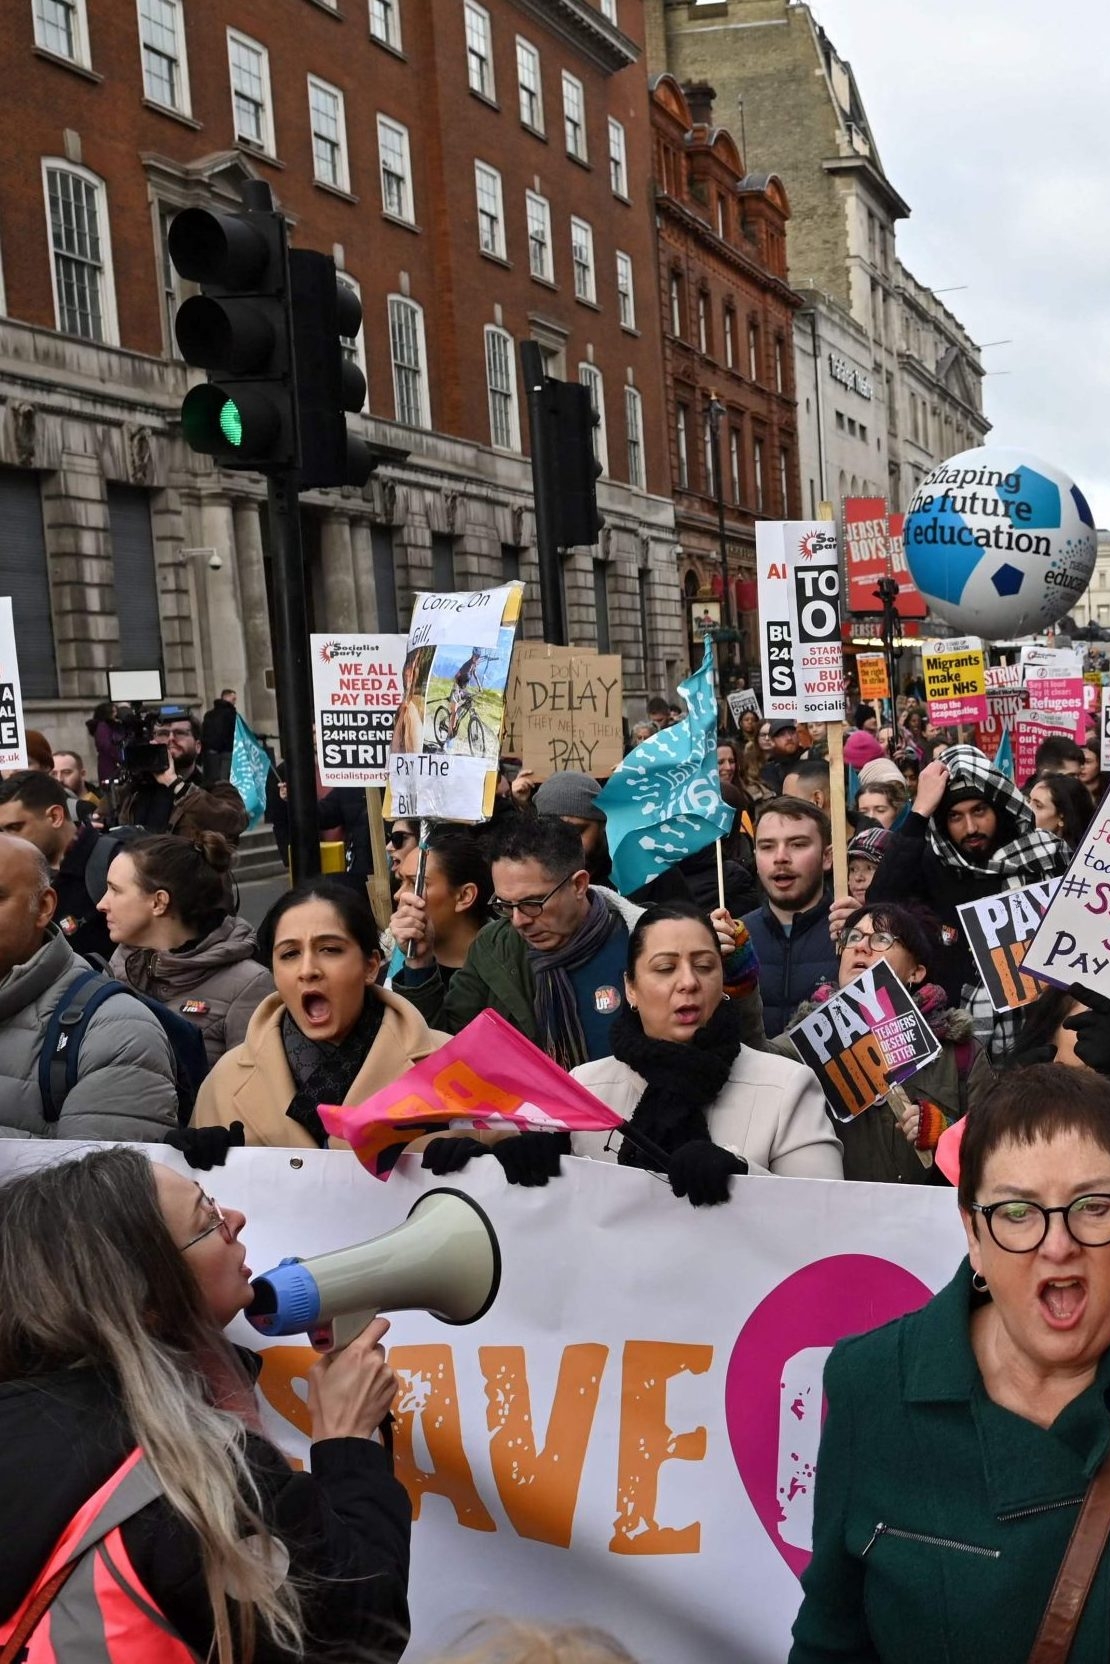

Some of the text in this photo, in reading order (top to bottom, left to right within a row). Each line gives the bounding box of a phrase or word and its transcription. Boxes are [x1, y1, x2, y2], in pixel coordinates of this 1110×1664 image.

[924, 465, 1021, 494] Shaping
[937, 487, 1032, 521] future
[847, 519, 887, 541] JERSEY
[914, 517, 1051, 557] education
[850, 538, 887, 563] BOYS
[422, 592, 491, 613] Come On
[333, 643, 380, 651] Socialist
[339, 663, 398, 676] WE ALL
[551, 660, 591, 679] DON'T
[927, 655, 980, 672] Migrants
[339, 679, 398, 690] NEED A
[928, 672, 961, 684] make
[527, 676, 618, 718] DELAY
[930, 686, 950, 697] our
[953, 681, 978, 695] NHS
[331, 693, 402, 706] PAY RISE
[930, 700, 961, 712] Stop the
[1030, 697, 1081, 710] Refugees
[322, 713, 368, 726] BUILD
[932, 706, 979, 719] scapegoating
[323, 730, 356, 741] 24HR
[527, 715, 553, 731] THEY
[589, 722, 621, 739] THEIR
[1020, 723, 1074, 740] Braverman
[396, 754, 449, 777] Pay The
[548, 738, 600, 773] PAY
[800, 969, 886, 1065] PAY
[875, 1014, 916, 1040] TEACHERS
[880, 1029, 916, 1053] DESERVE
[885, 1044, 917, 1065] BETTER
